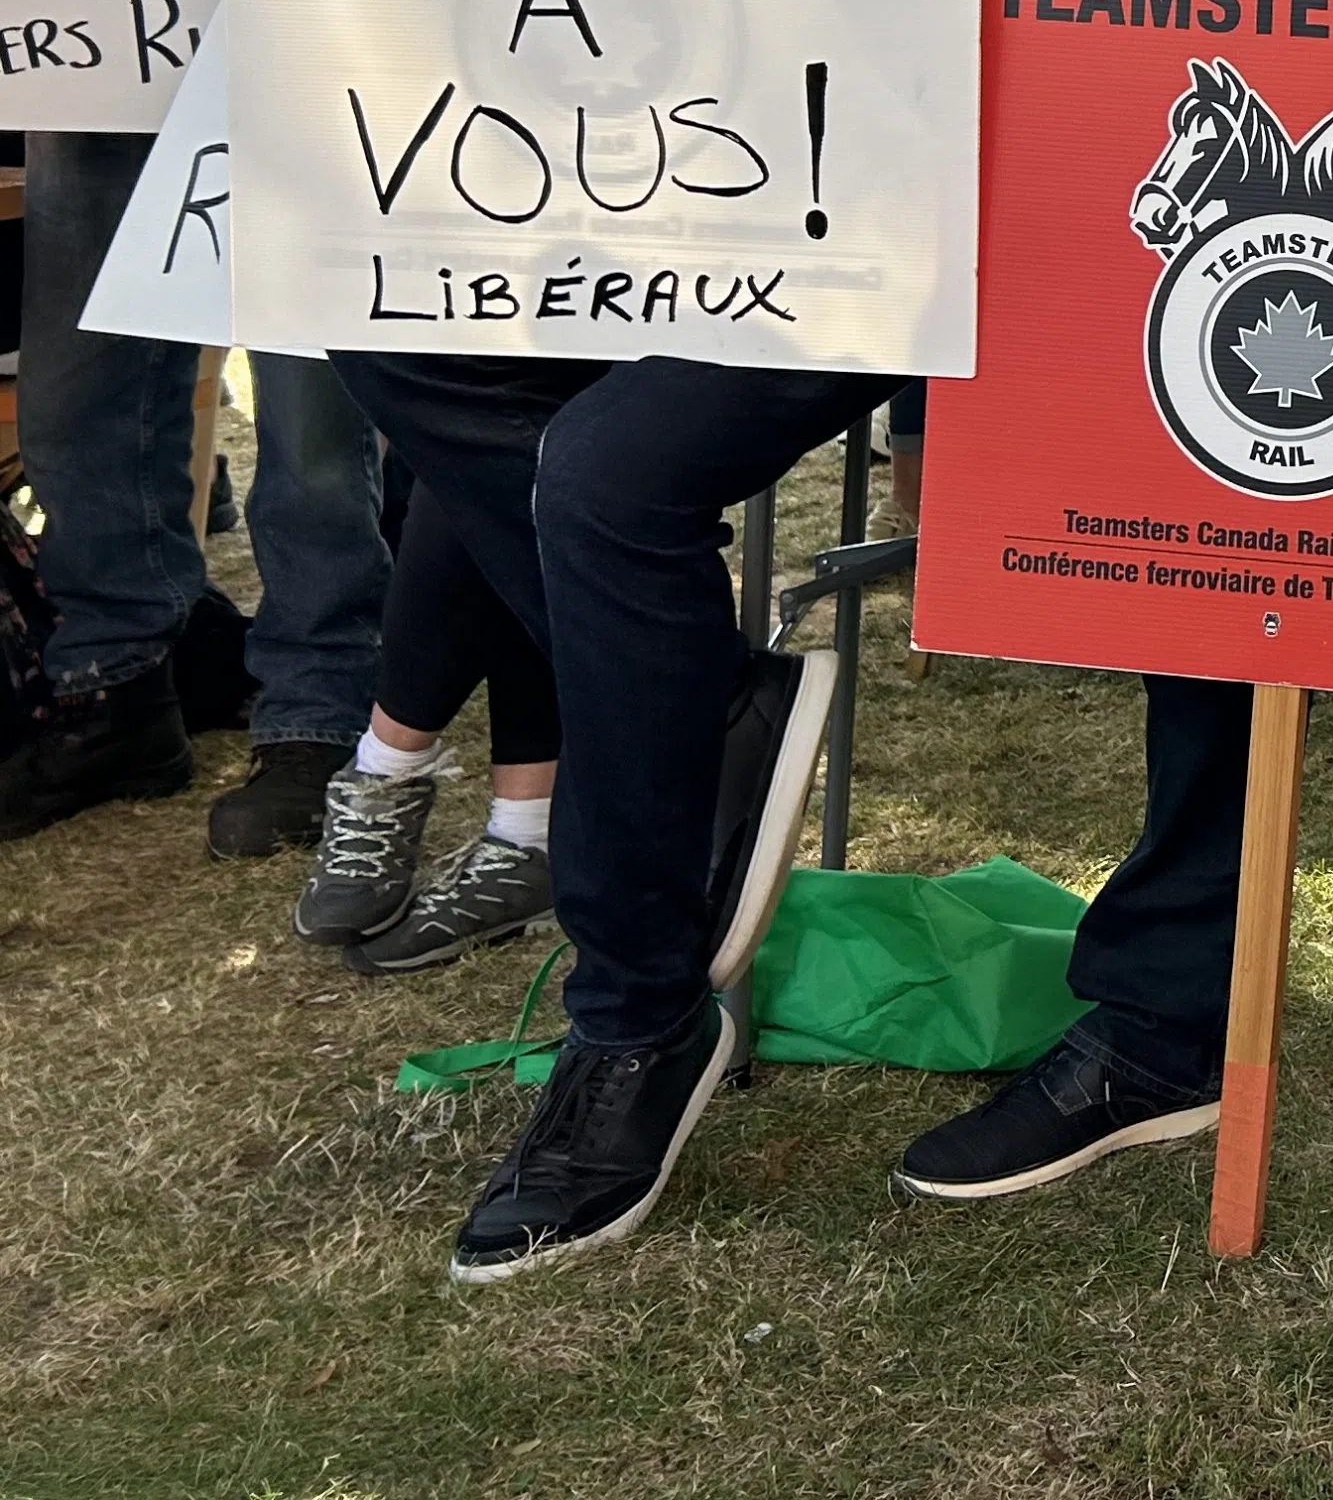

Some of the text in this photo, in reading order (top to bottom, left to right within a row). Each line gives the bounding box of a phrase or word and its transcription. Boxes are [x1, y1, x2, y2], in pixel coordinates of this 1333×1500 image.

[347, 60, 828, 240] VOUS!
[1249, 439, 1315, 468] RAIL
[1064, 508, 1190, 545] Teamsters
[1196, 520, 1290, 553] Canada
[1002, 547, 1139, 583] Conférence
[1146, 560, 1276, 597] ferroviaire
[1283, 571, 1315, 600] de
